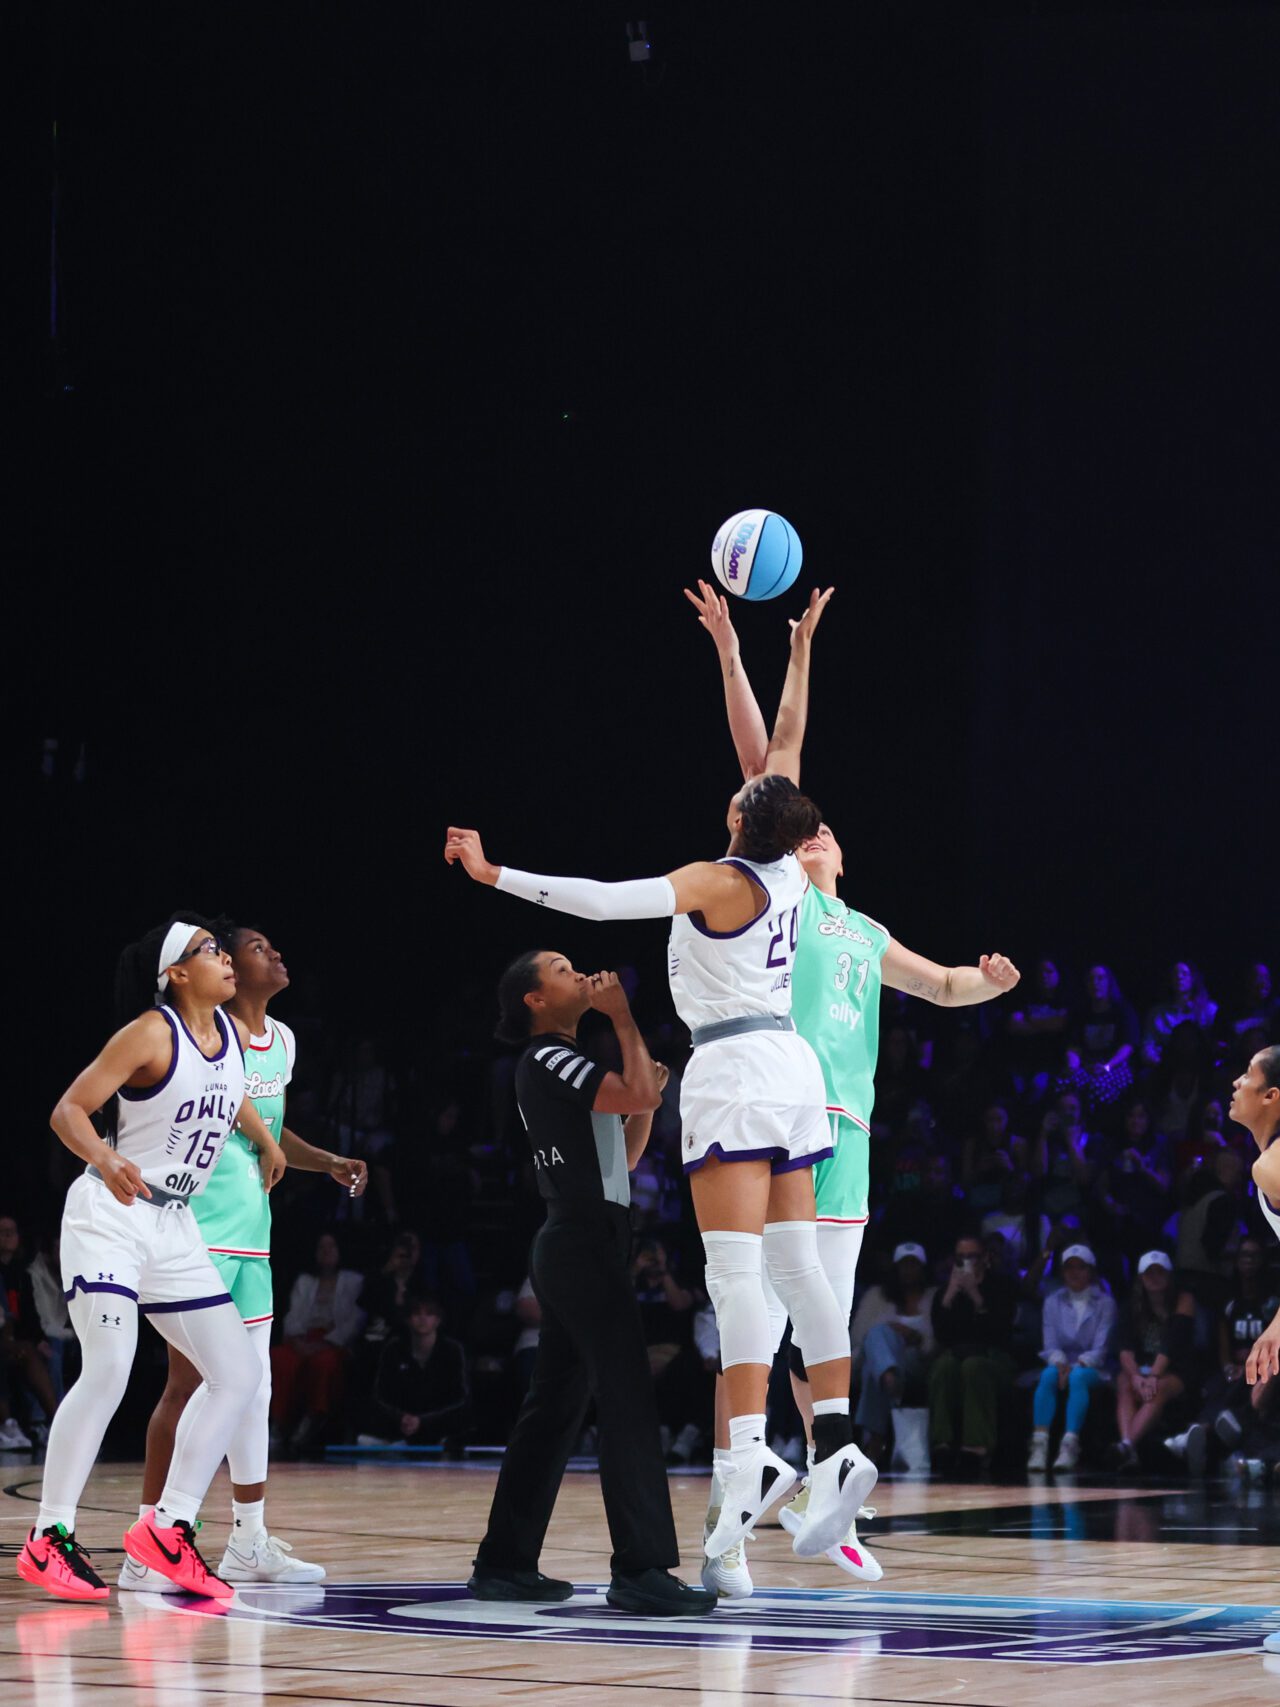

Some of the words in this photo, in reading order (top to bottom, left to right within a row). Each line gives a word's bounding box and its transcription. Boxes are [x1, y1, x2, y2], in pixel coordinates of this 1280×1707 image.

[728, 522, 757, 580] Wilson
[834, 952, 870, 998] 31
[829, 1002, 861, 1031] ally
[205, 1083, 228, 1093] LUNAR
[174, 1094, 235, 1127] OWLS
[183, 1129, 221, 1170] 15
[165, 1172, 200, 1196] ally
